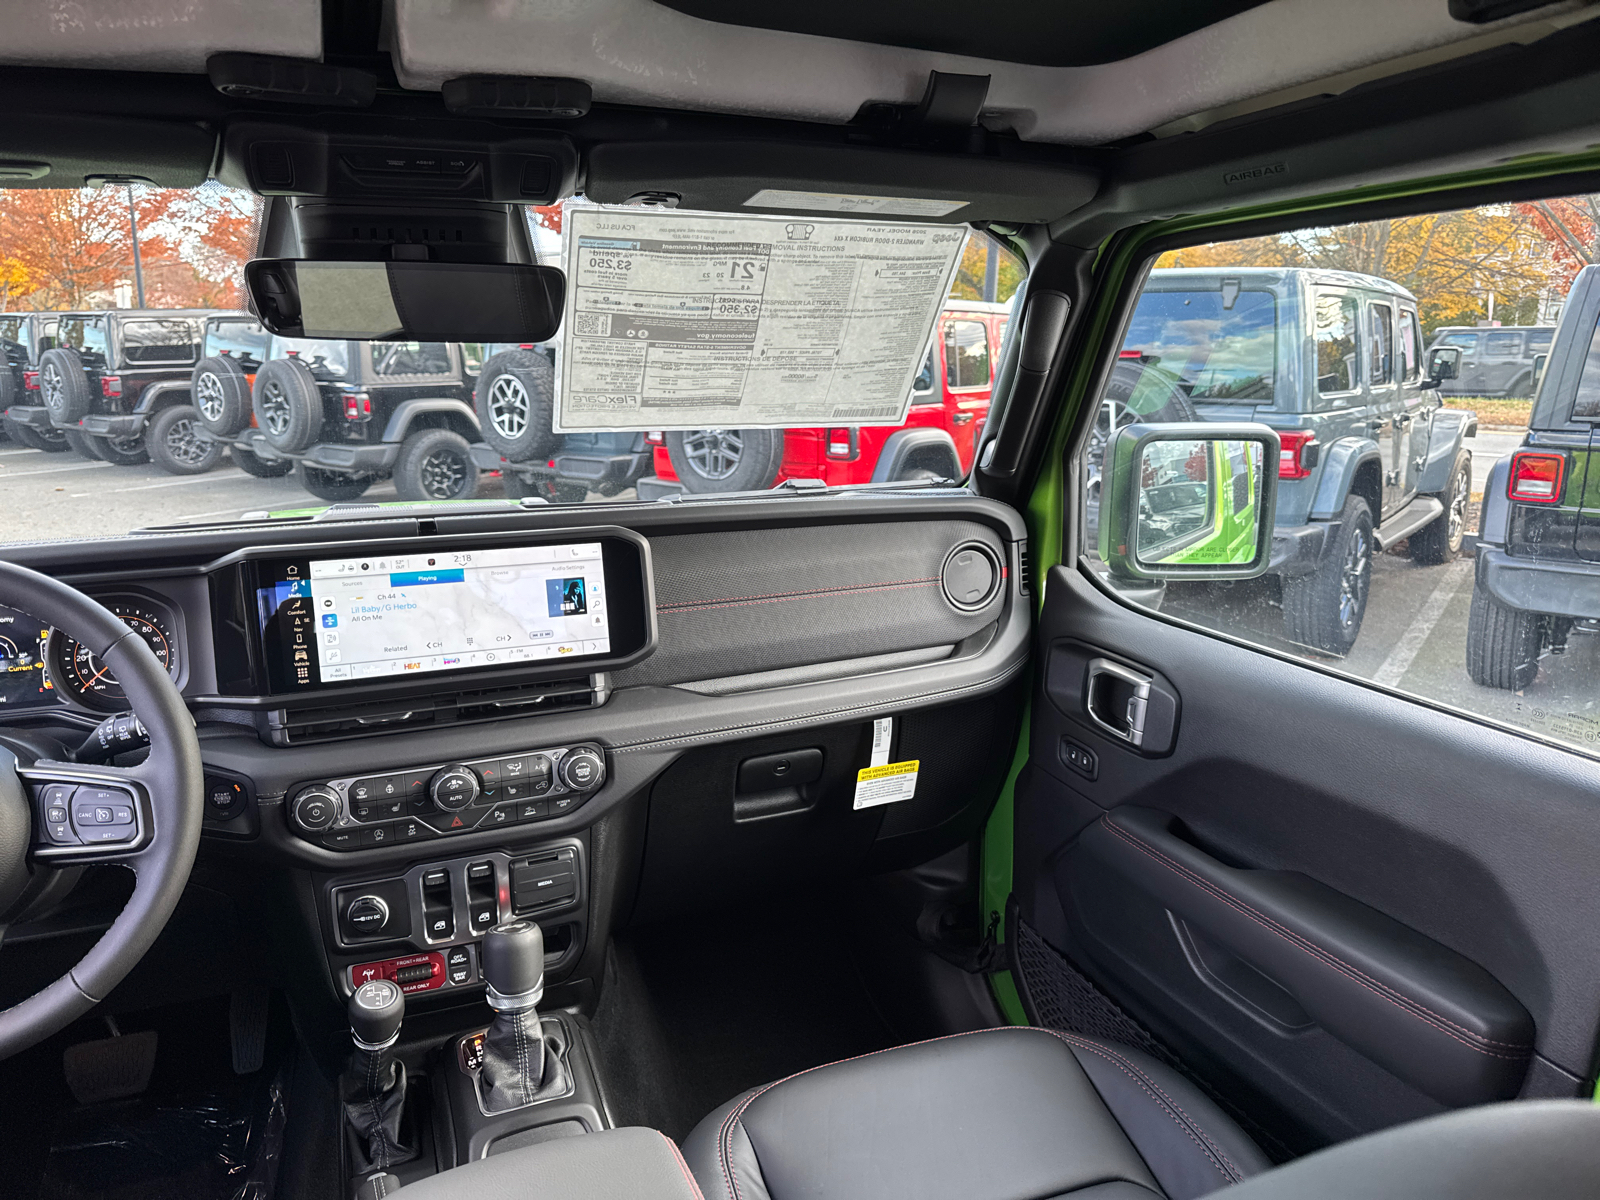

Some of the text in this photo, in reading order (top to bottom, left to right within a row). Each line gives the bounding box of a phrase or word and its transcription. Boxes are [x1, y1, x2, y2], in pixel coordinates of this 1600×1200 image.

[1229, 164, 1286, 182] AIRBAG
[454, 554, 472, 562] 2:18
[872, 770, 895, 778] ADVANCED
